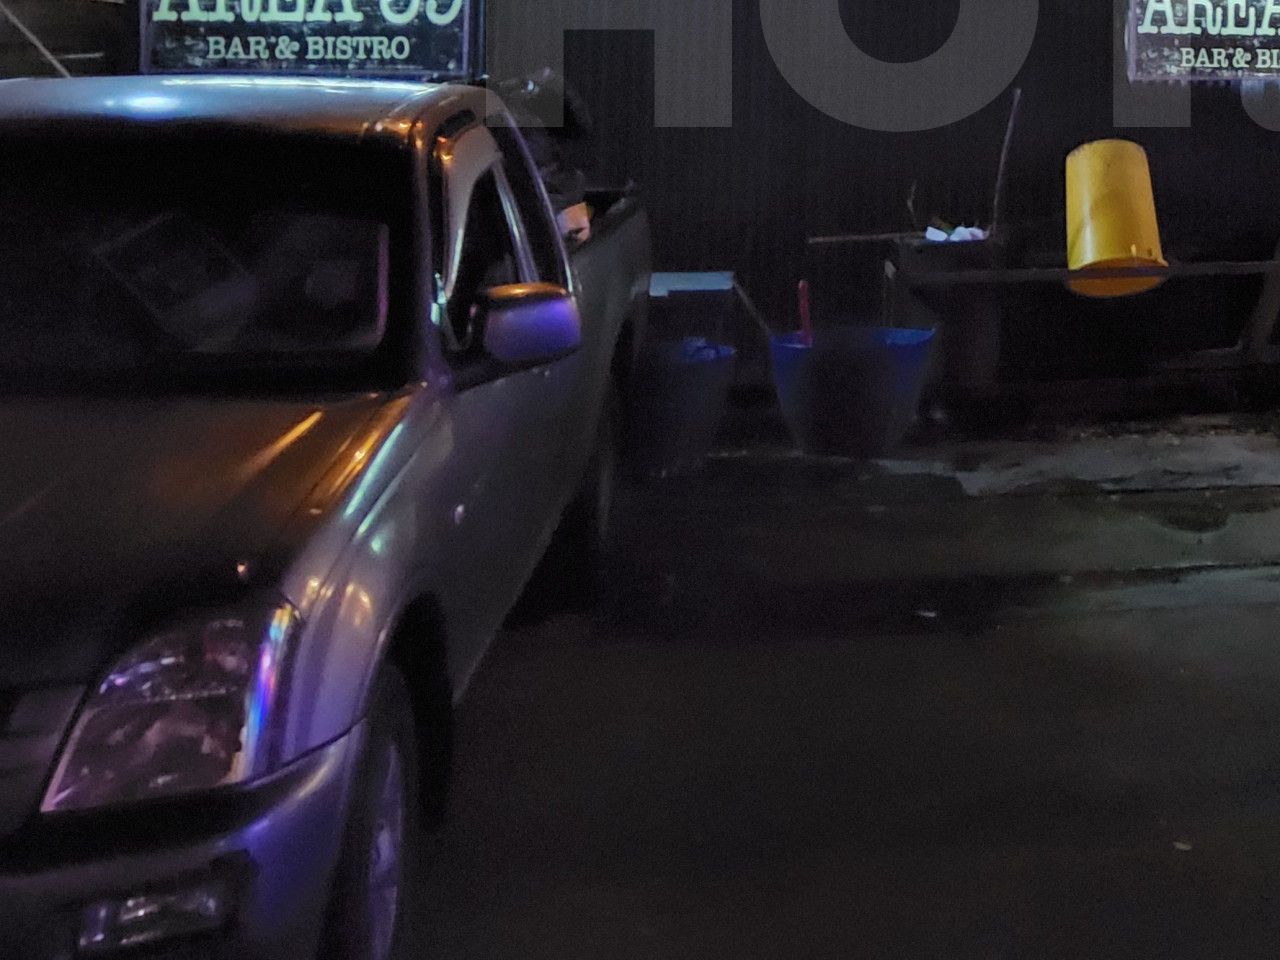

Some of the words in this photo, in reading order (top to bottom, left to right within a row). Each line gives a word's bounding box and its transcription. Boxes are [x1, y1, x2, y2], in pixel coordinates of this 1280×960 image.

[206, 36, 270, 60] BAR
[273, 35, 300, 60] &
[304, 36, 411, 60] BISTRO
[1180, 47, 1228, 68] BAR
[1232, 47, 1251, 69] &
